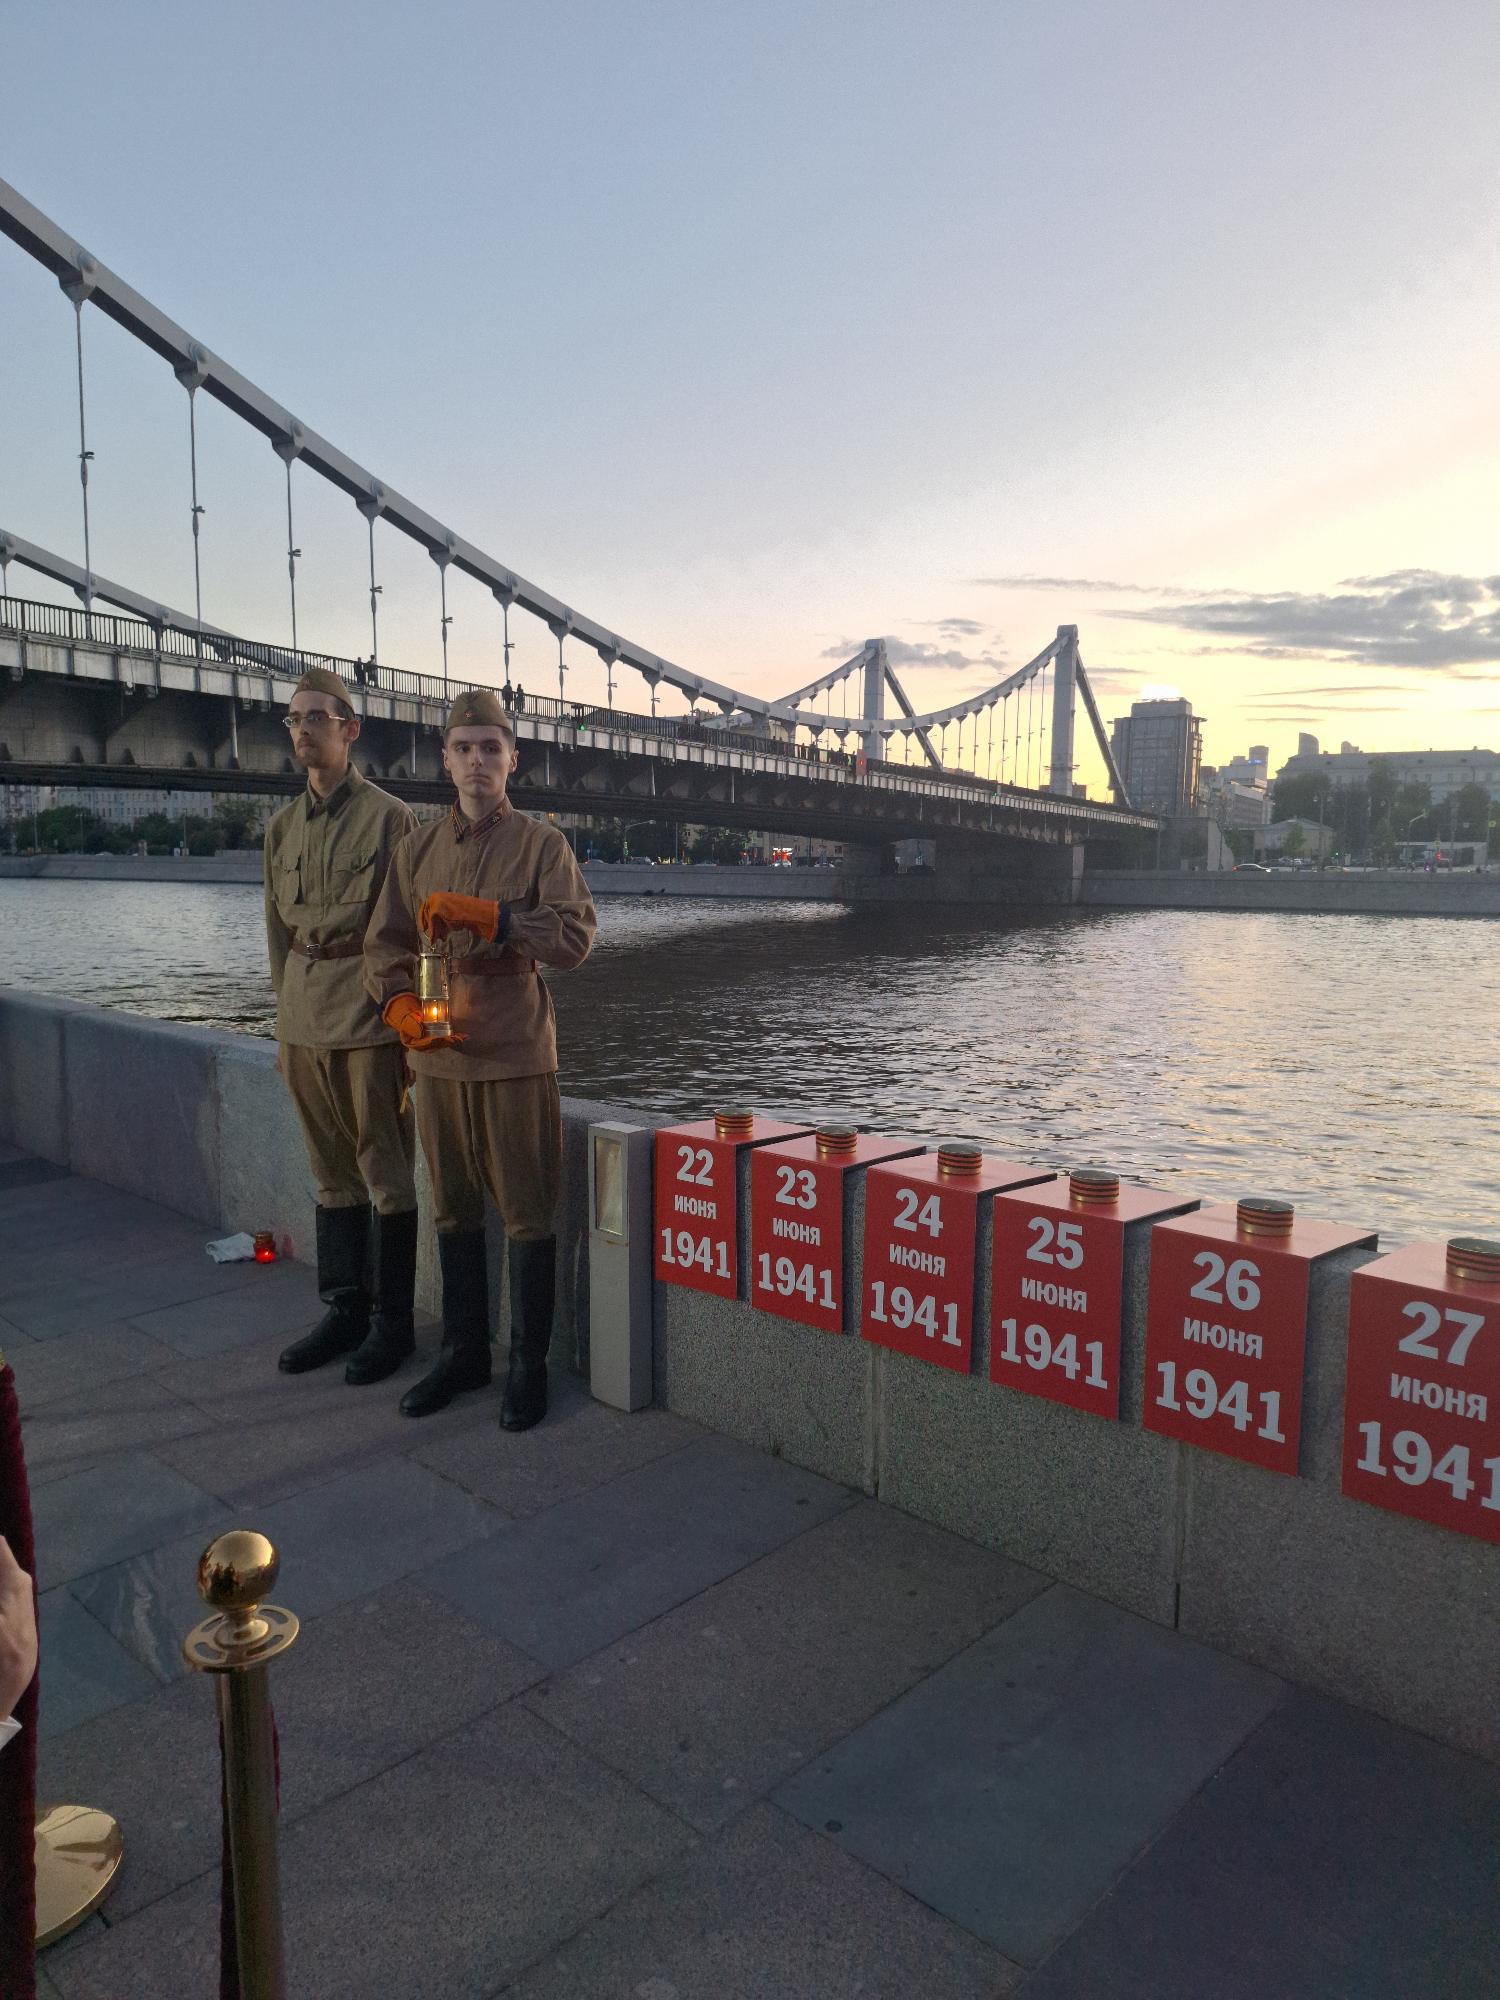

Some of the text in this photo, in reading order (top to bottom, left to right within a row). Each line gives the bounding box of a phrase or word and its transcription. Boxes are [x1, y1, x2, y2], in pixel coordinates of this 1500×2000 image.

[678, 1147, 713, 1187] 22
[776, 1166, 817, 1209] 23
[894, 1189, 943, 1237] 24
[662, 1229, 731, 1278] 1941
[1026, 1217, 1083, 1269] 25
[759, 1253, 837, 1309] 1941
[1191, 1252, 1260, 1310] 26
[871, 1281, 961, 1346] 1941
[1399, 1301, 1485, 1366] 27
[1001, 1319, 1107, 1389] 1941
[1156, 1361, 1285, 1443] 1941
[1357, 1421, 1500, 1511] 1941
